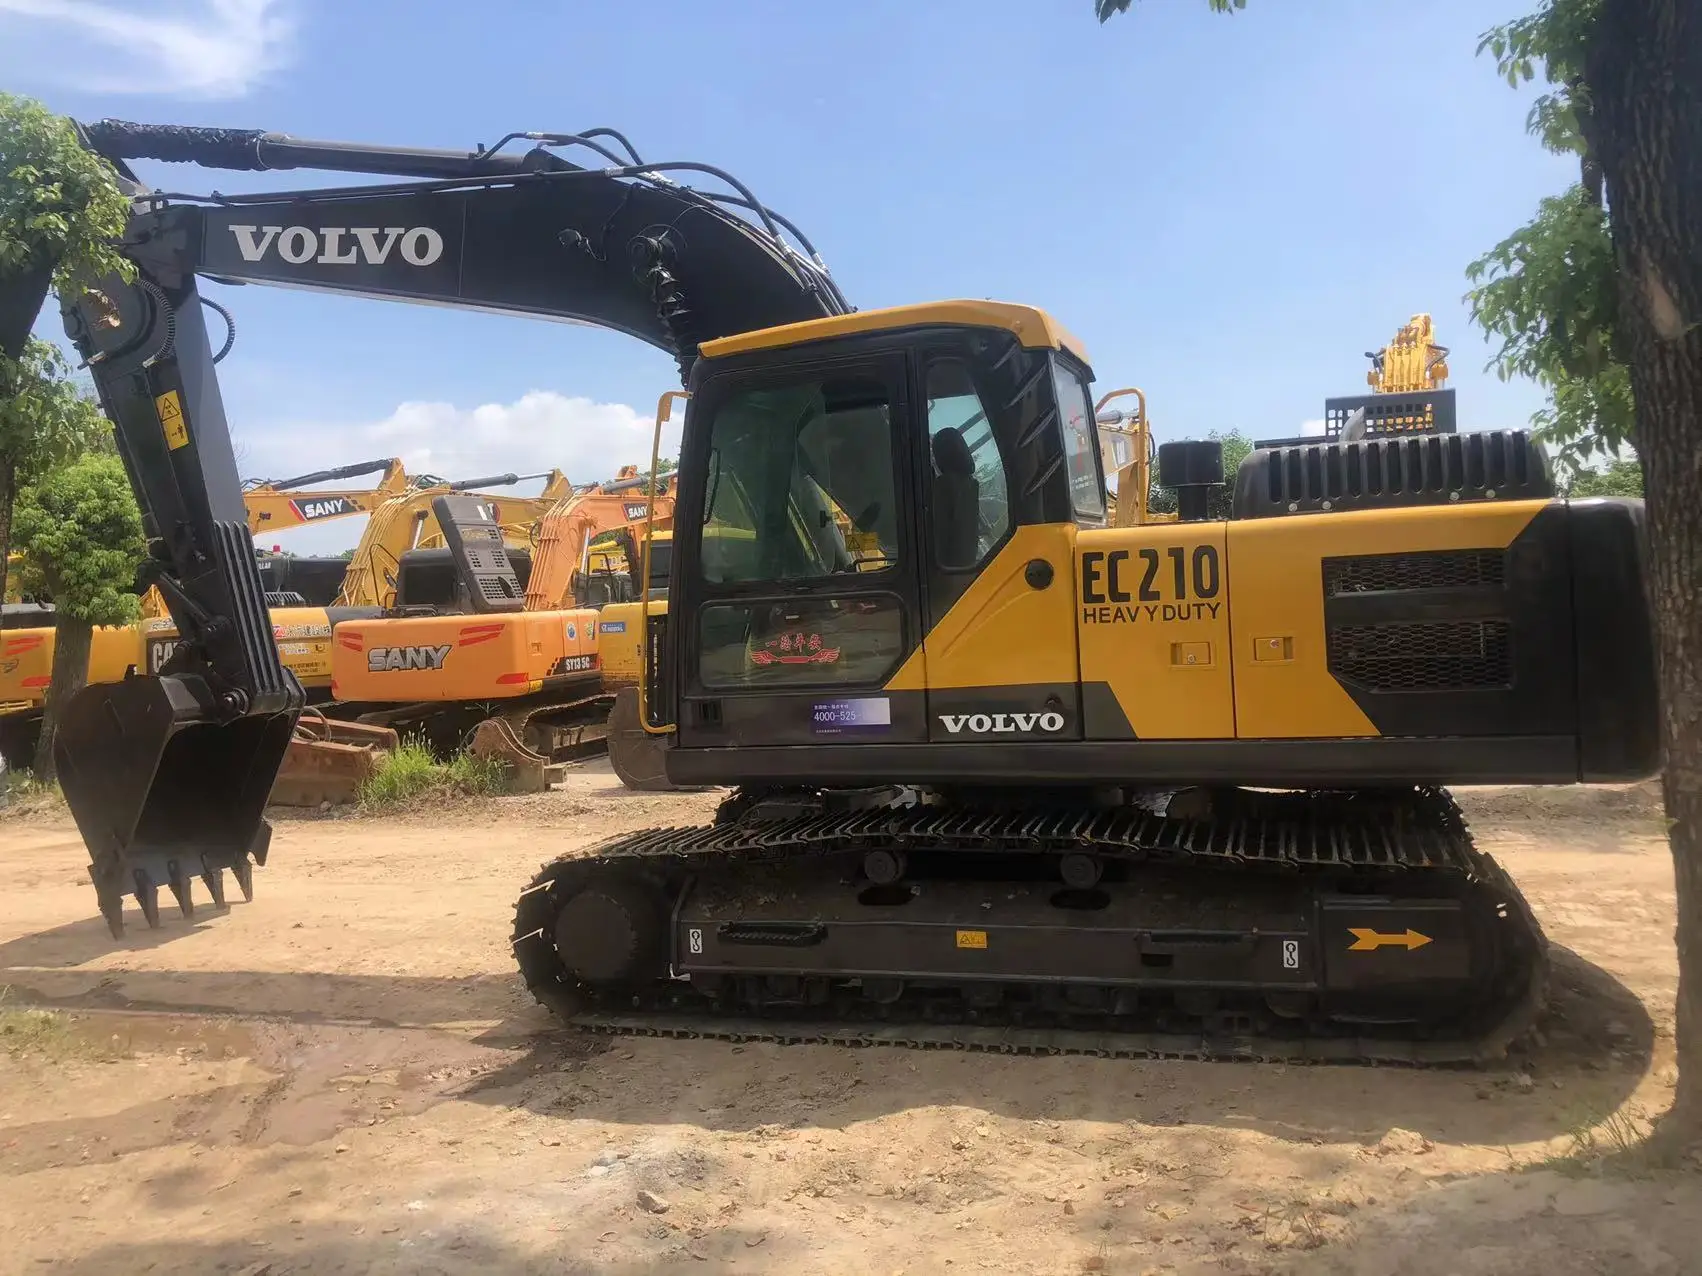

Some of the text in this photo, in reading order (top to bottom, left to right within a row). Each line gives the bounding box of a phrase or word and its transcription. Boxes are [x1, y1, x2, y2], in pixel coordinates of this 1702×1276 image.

[228, 224, 443, 266] VOLVO
[305, 499, 343, 518] SANY
[1082, 545, 1220, 604] EC210
[368, 645, 452, 672] SANY
[938, 712, 1065, 733] VOLVO
